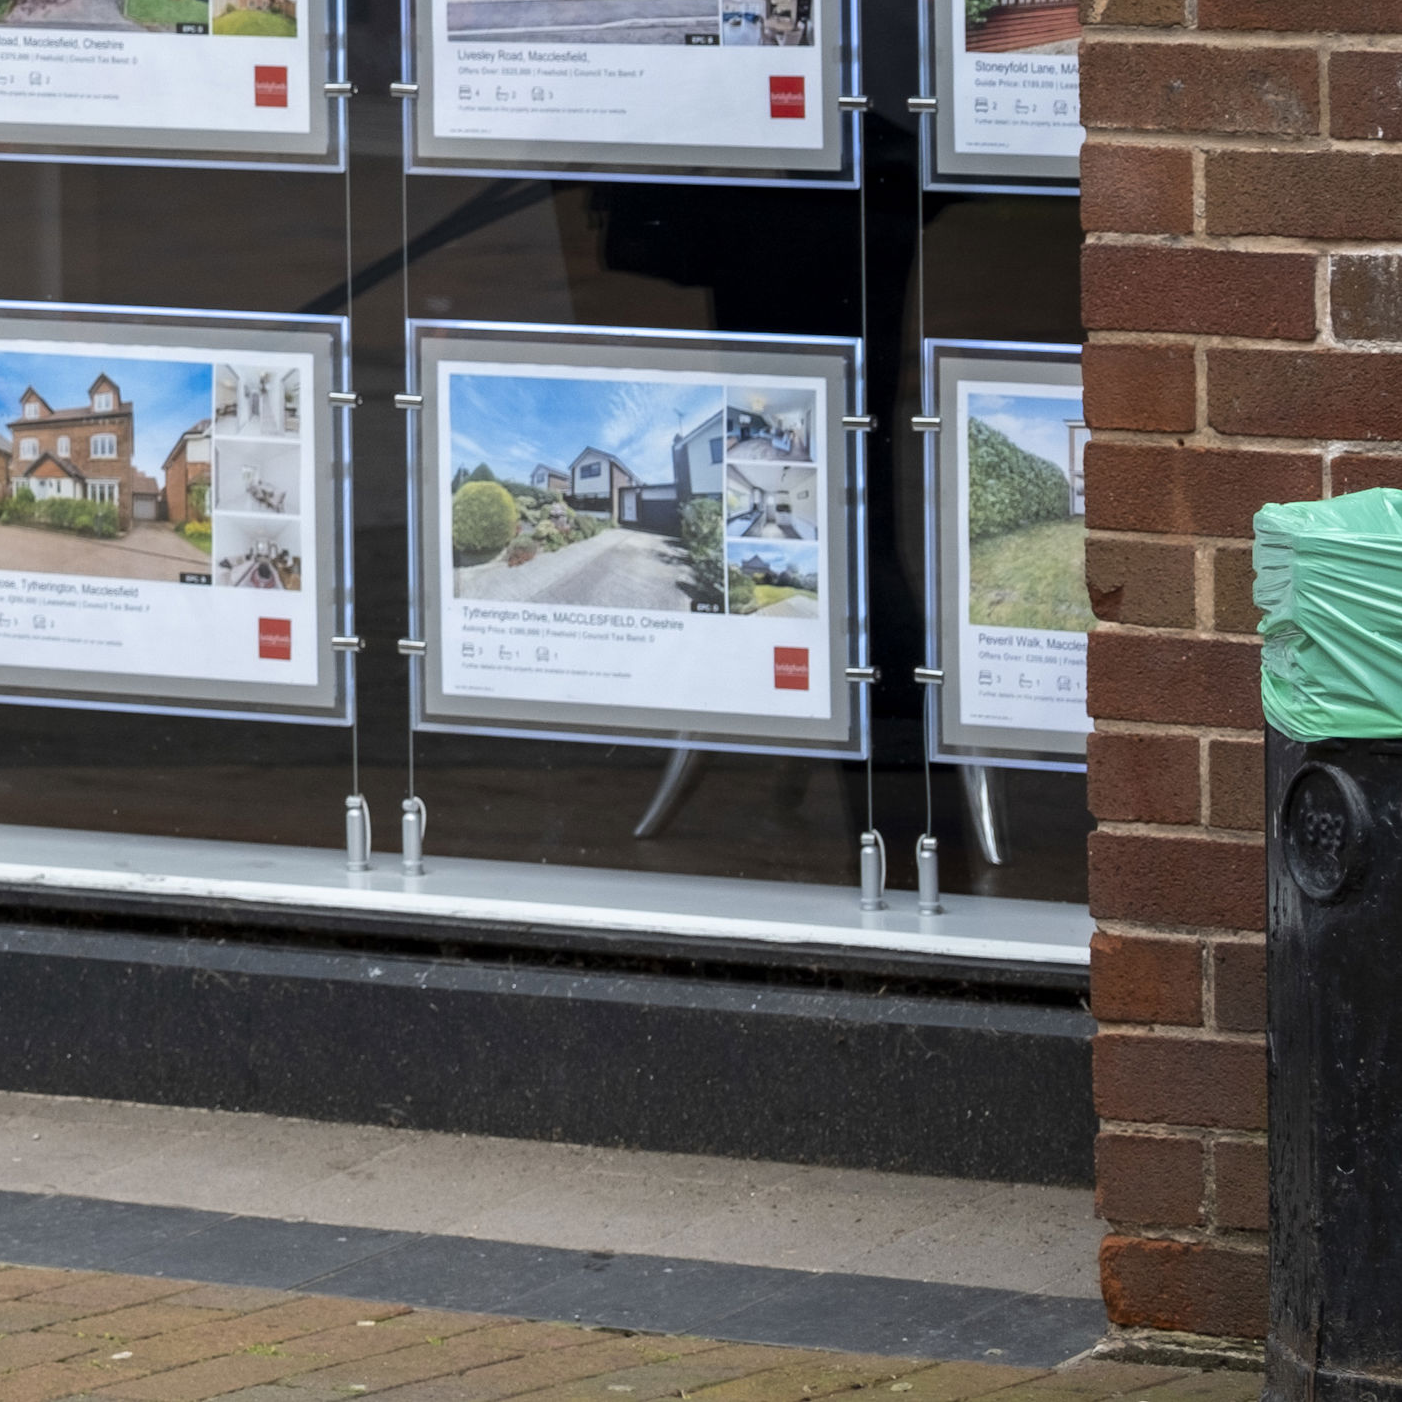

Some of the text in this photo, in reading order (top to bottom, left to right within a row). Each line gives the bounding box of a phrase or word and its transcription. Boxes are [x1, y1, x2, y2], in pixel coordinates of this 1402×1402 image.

[83, 37, 124, 49] Cheshire
[458, 50, 590, 63] Livesley Road, Macclesfield,
[975, 60, 1028, 75] Stoneyfold
[1031, 63, 1058, 75] Lane,
[463, 606, 684, 631] Tytherington Drive, MACCLESFIELD, Cheshire
[978, 633, 1087, 651] Peveril Walk, Maccles
